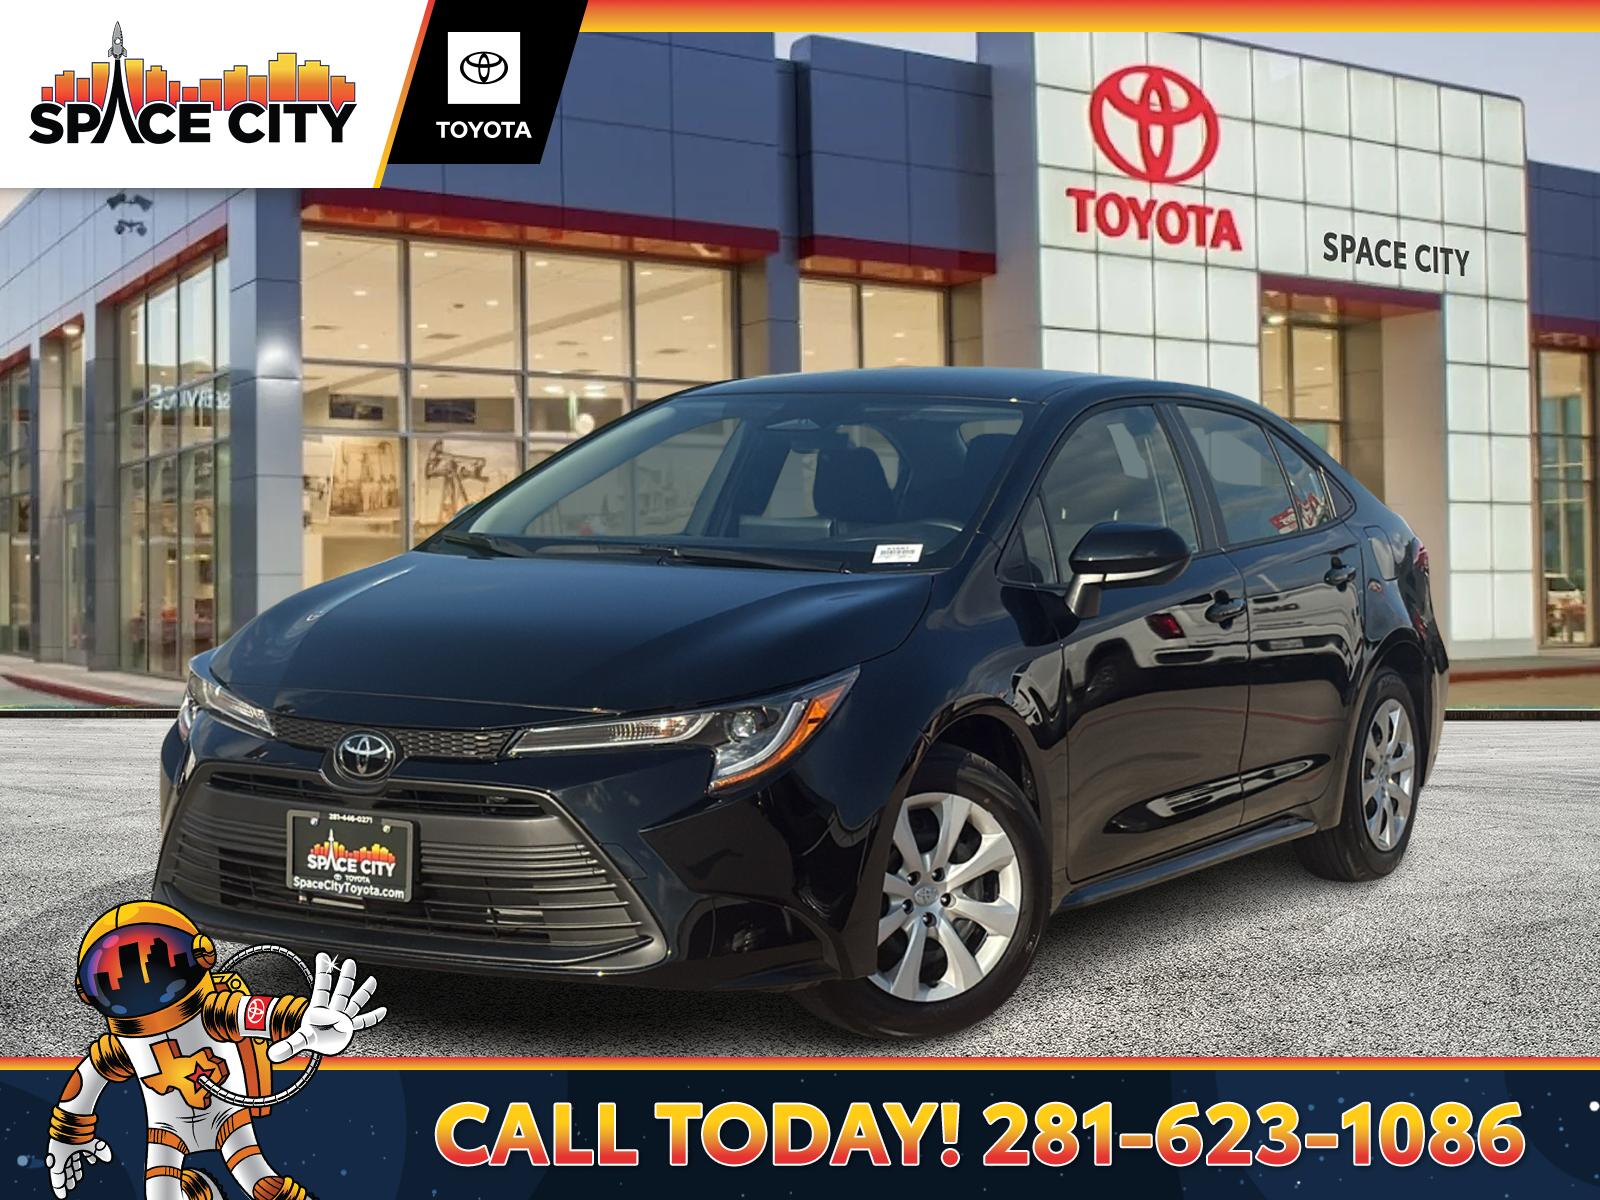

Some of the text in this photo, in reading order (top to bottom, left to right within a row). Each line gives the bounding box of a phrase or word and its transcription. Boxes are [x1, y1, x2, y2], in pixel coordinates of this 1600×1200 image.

[1066, 187, 1242, 251] TOYOTA
[1323, 231, 1471, 278] SPACE CITY
[307, 853, 396, 878] SPACE CITY
[293, 875, 405, 900] SpaceCityToyota.com
[345, 874, 371, 884] TOYOTA
